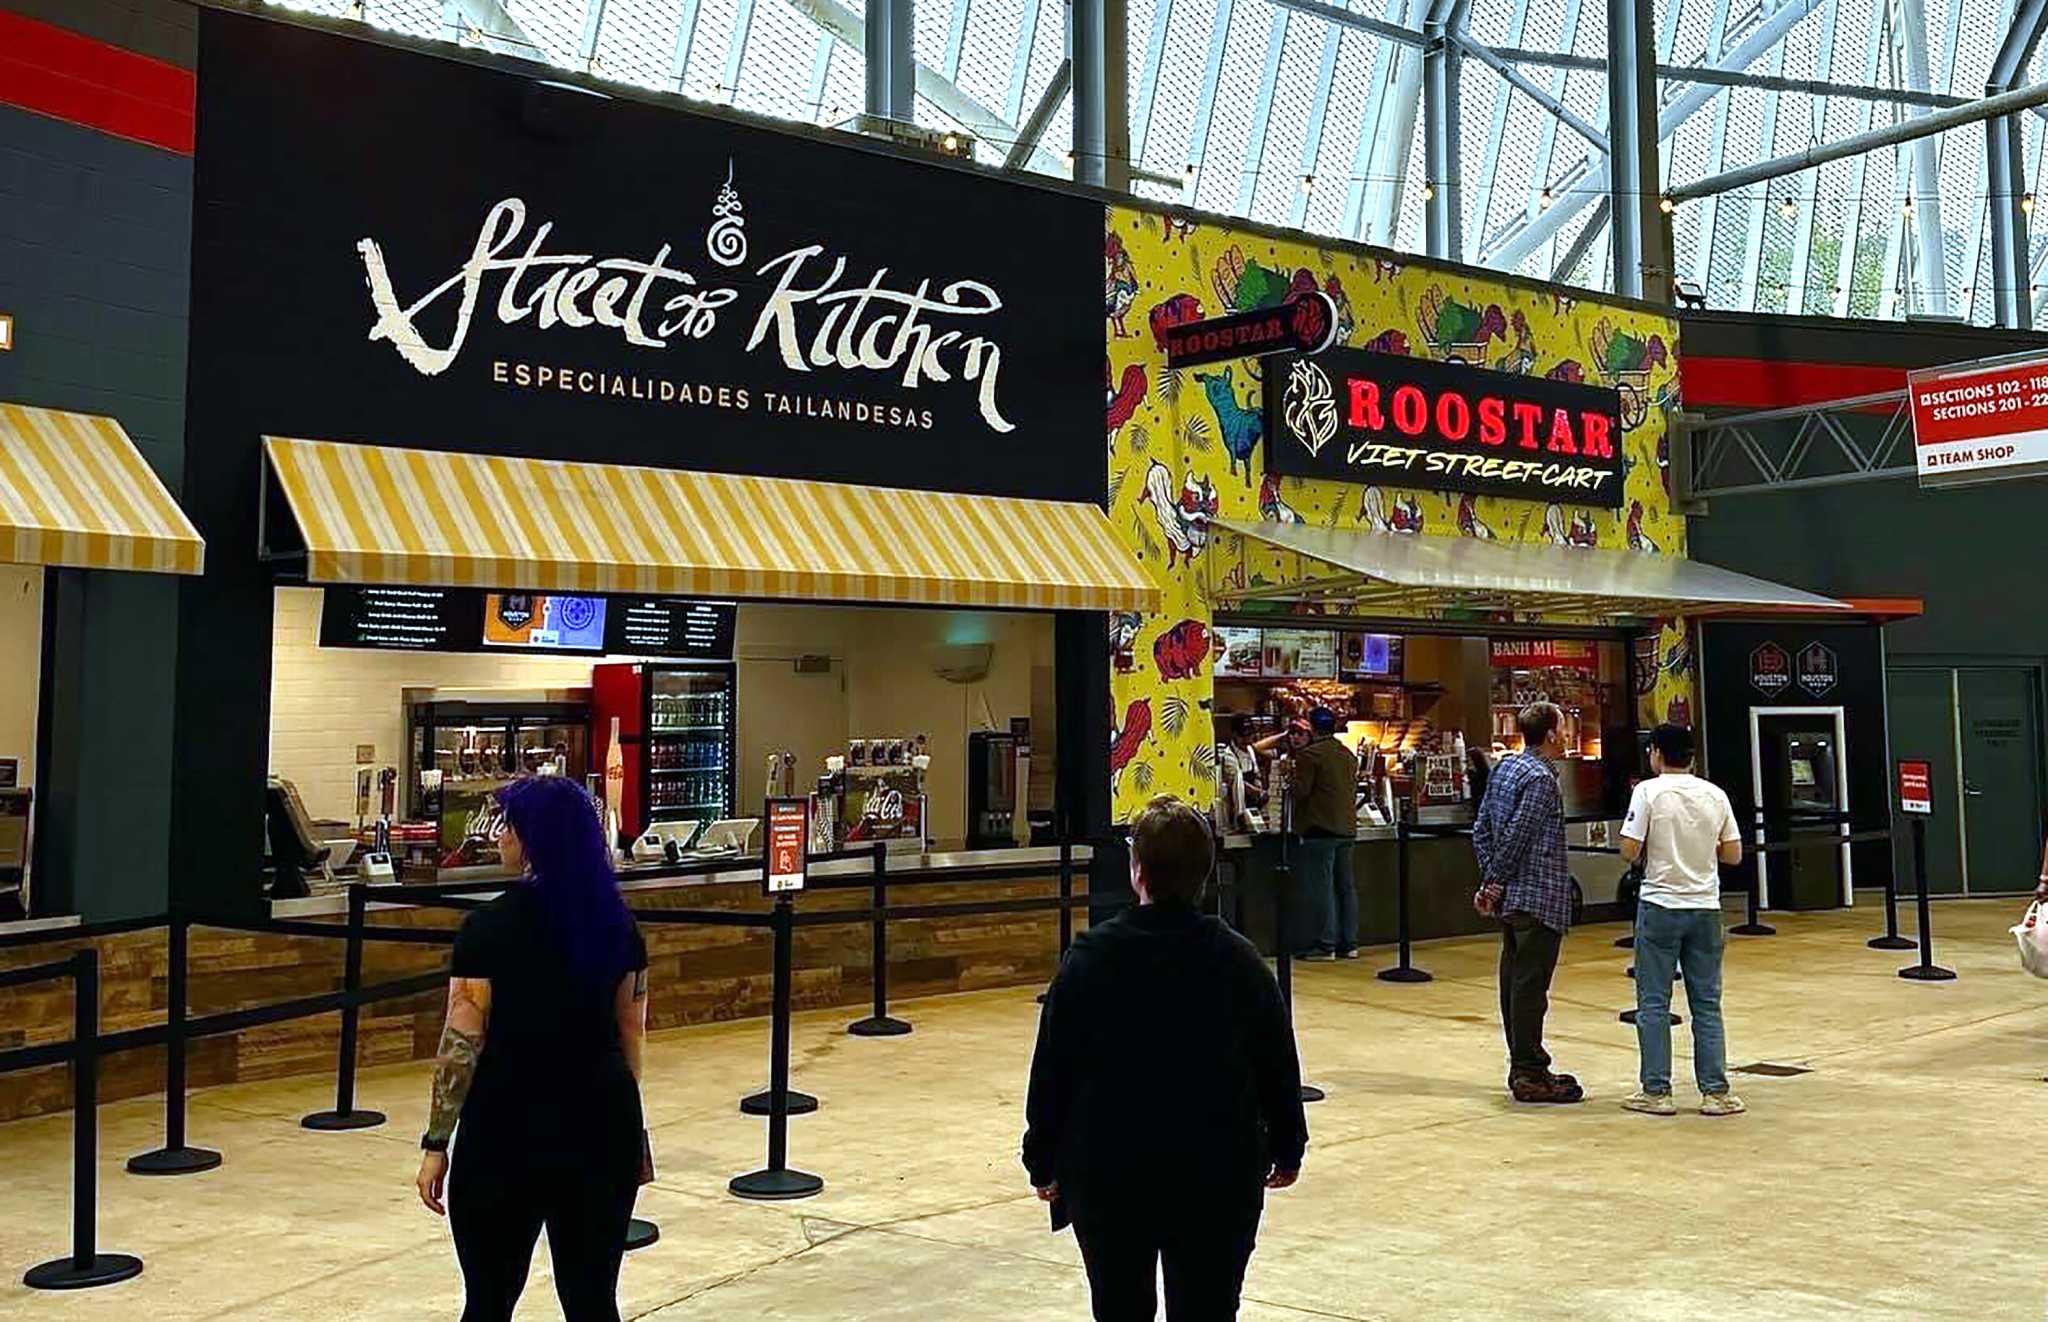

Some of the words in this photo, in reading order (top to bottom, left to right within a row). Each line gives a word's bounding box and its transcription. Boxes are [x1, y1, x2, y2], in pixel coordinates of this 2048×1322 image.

[356, 197, 695, 376] Street
[745, 244, 1015, 432] Kitchen
[1170, 319, 1283, 357] ROOSTAR
[493, 361, 750, 410] ESPECIALIDADES
[764, 393, 934, 429] TAILANDESAS
[1931, 384, 1994, 405] SECTIONS
[1997, 380, 2021, 395] 102
[1933, 400, 1996, 421] SECTIONS
[1998, 397, 2022, 412] 201
[1347, 378, 1614, 459] ROOSTAR
[1347, 441, 1427, 470] VIET
[1425, 452, 1613, 490] STREET-CART
[1939, 451, 1974, 465] TEAM
[1975, 445, 2015, 460] SHOP
[1493, 641, 1530, 656] BANH
[1533, 640, 1552, 656] MI
